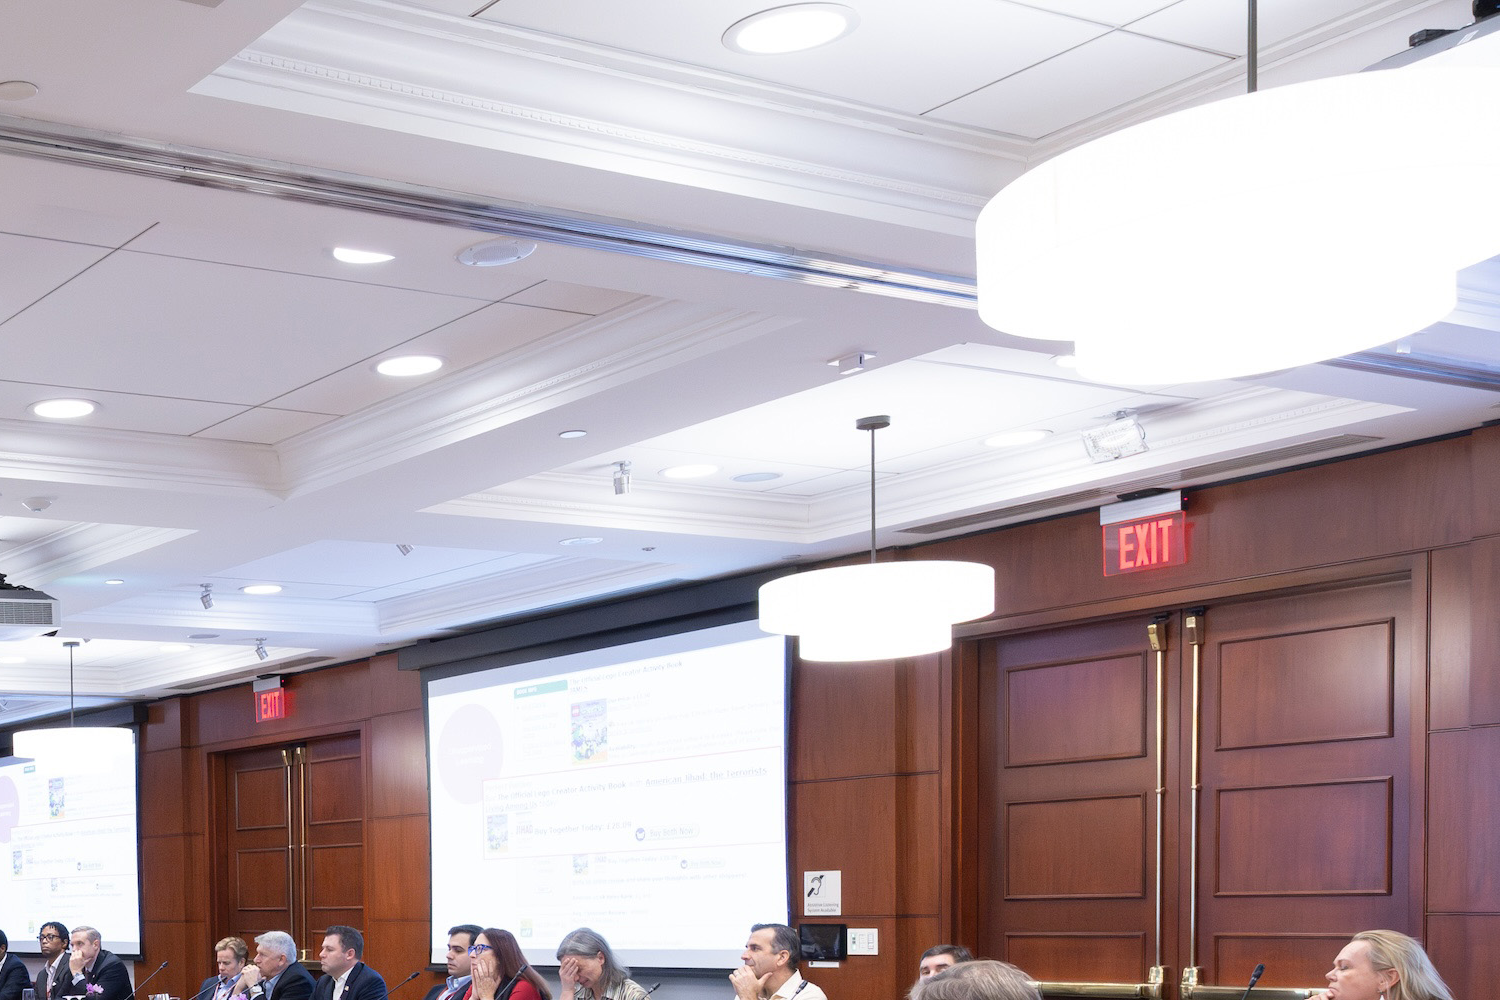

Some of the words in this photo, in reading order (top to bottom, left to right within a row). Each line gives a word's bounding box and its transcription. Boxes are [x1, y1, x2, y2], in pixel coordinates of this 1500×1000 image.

[1118, 518, 1173, 570] EXIT
[667, 660, 682, 669] Book
[261, 691, 280, 719] EXIT
[552, 786, 577, 795] Creator
[579, 783, 606, 793] Activity
[608, 781, 626, 790] Book
[645, 776, 682, 786] American
[710, 770, 724, 780] the
[727, 767, 768, 778] Terrorists
[516, 825, 534, 835] JIHAD
[534, 827, 547, 836] Buy
[550, 824, 579, 835] Together
[680, 826, 694, 835] Now
